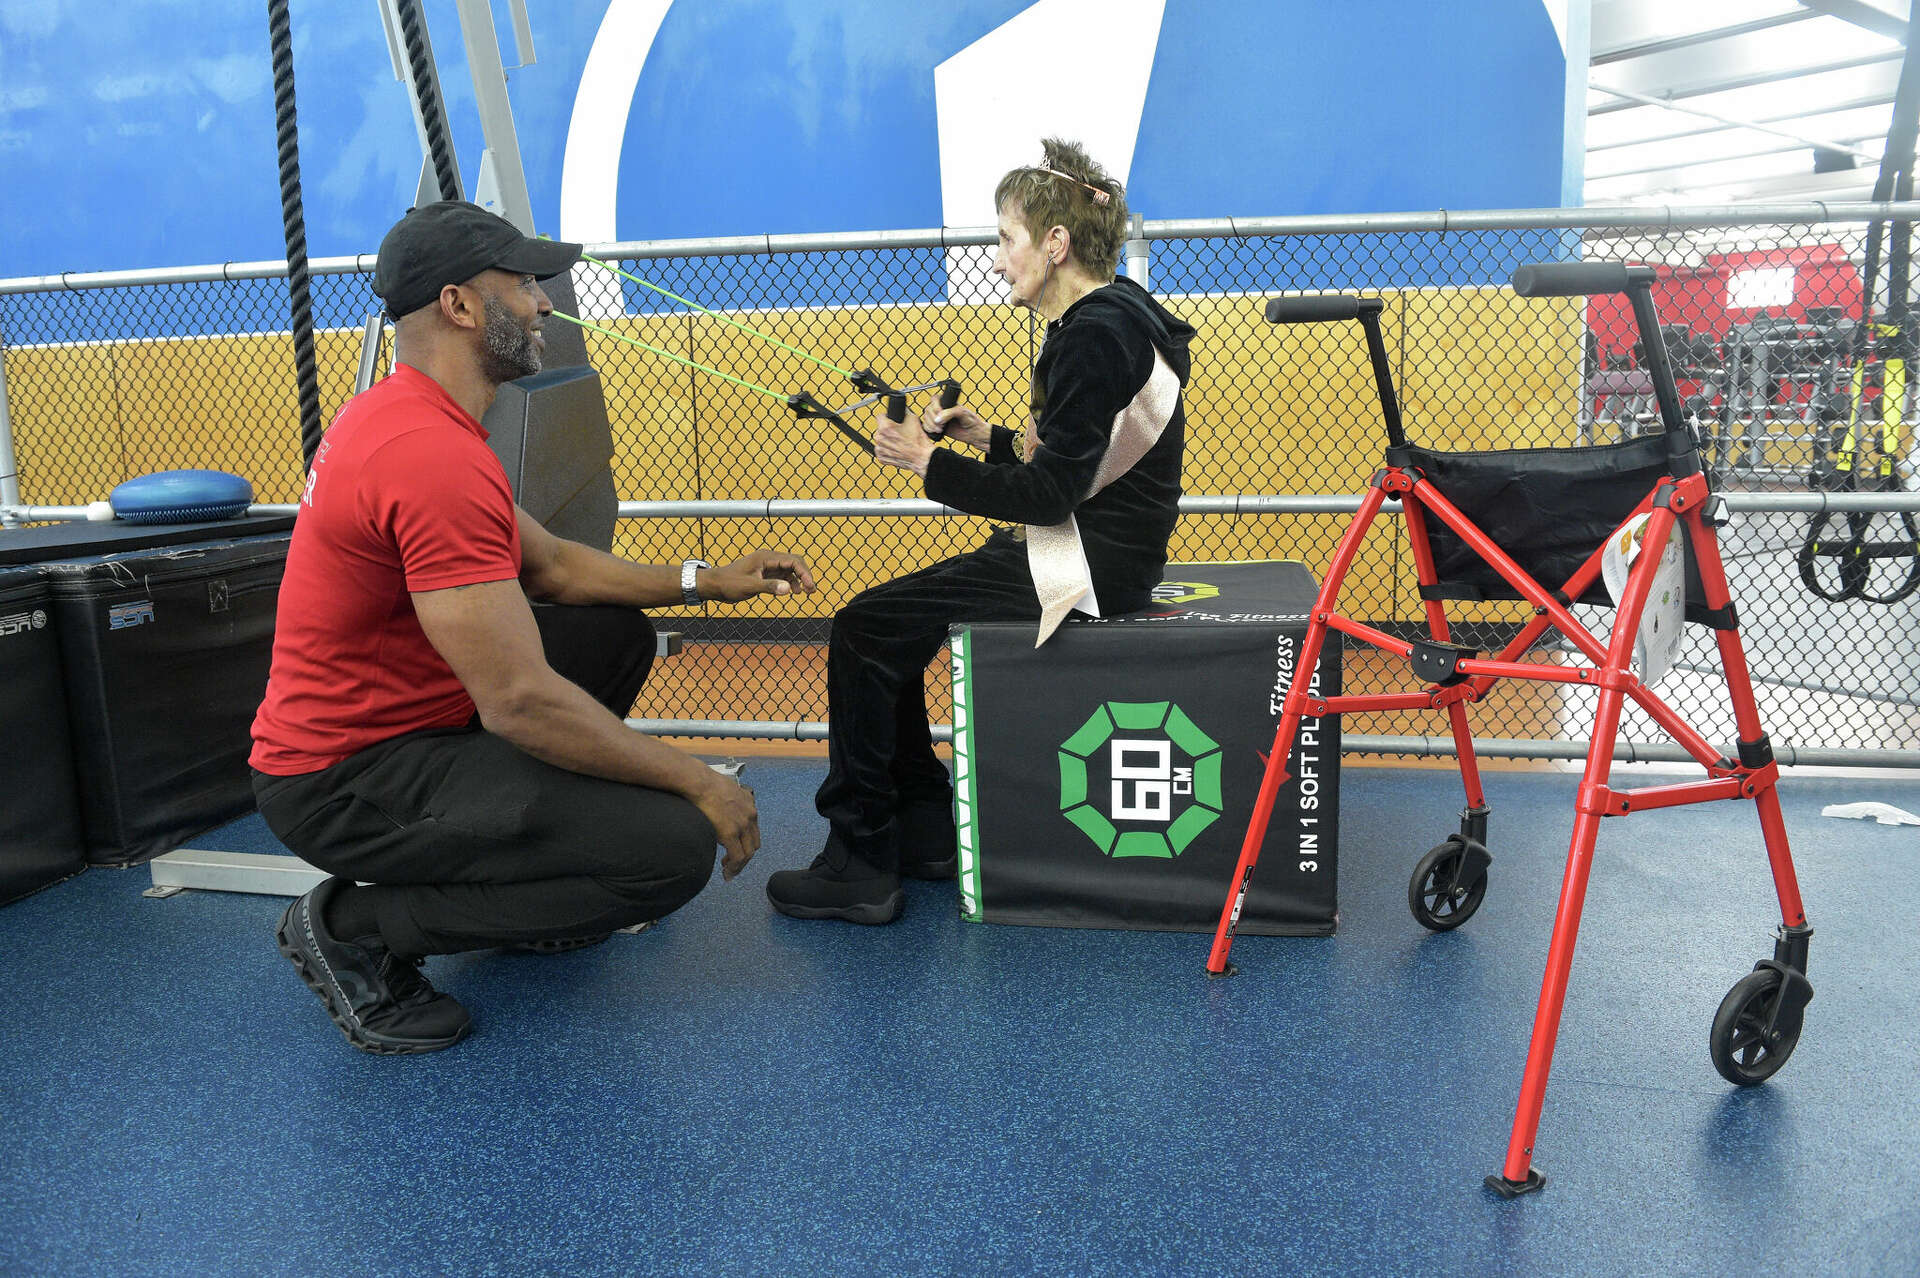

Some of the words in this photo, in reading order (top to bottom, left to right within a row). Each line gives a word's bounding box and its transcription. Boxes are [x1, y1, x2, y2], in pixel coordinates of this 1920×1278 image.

[1111, 739, 1171, 821] 60
[1172, 767, 1192, 794] CM
[1299, 752, 1319, 810] SOFT
[1299, 818, 1318, 827] 1
[1299, 834, 1318, 855] IN
[1299, 860, 1318, 872] 3
